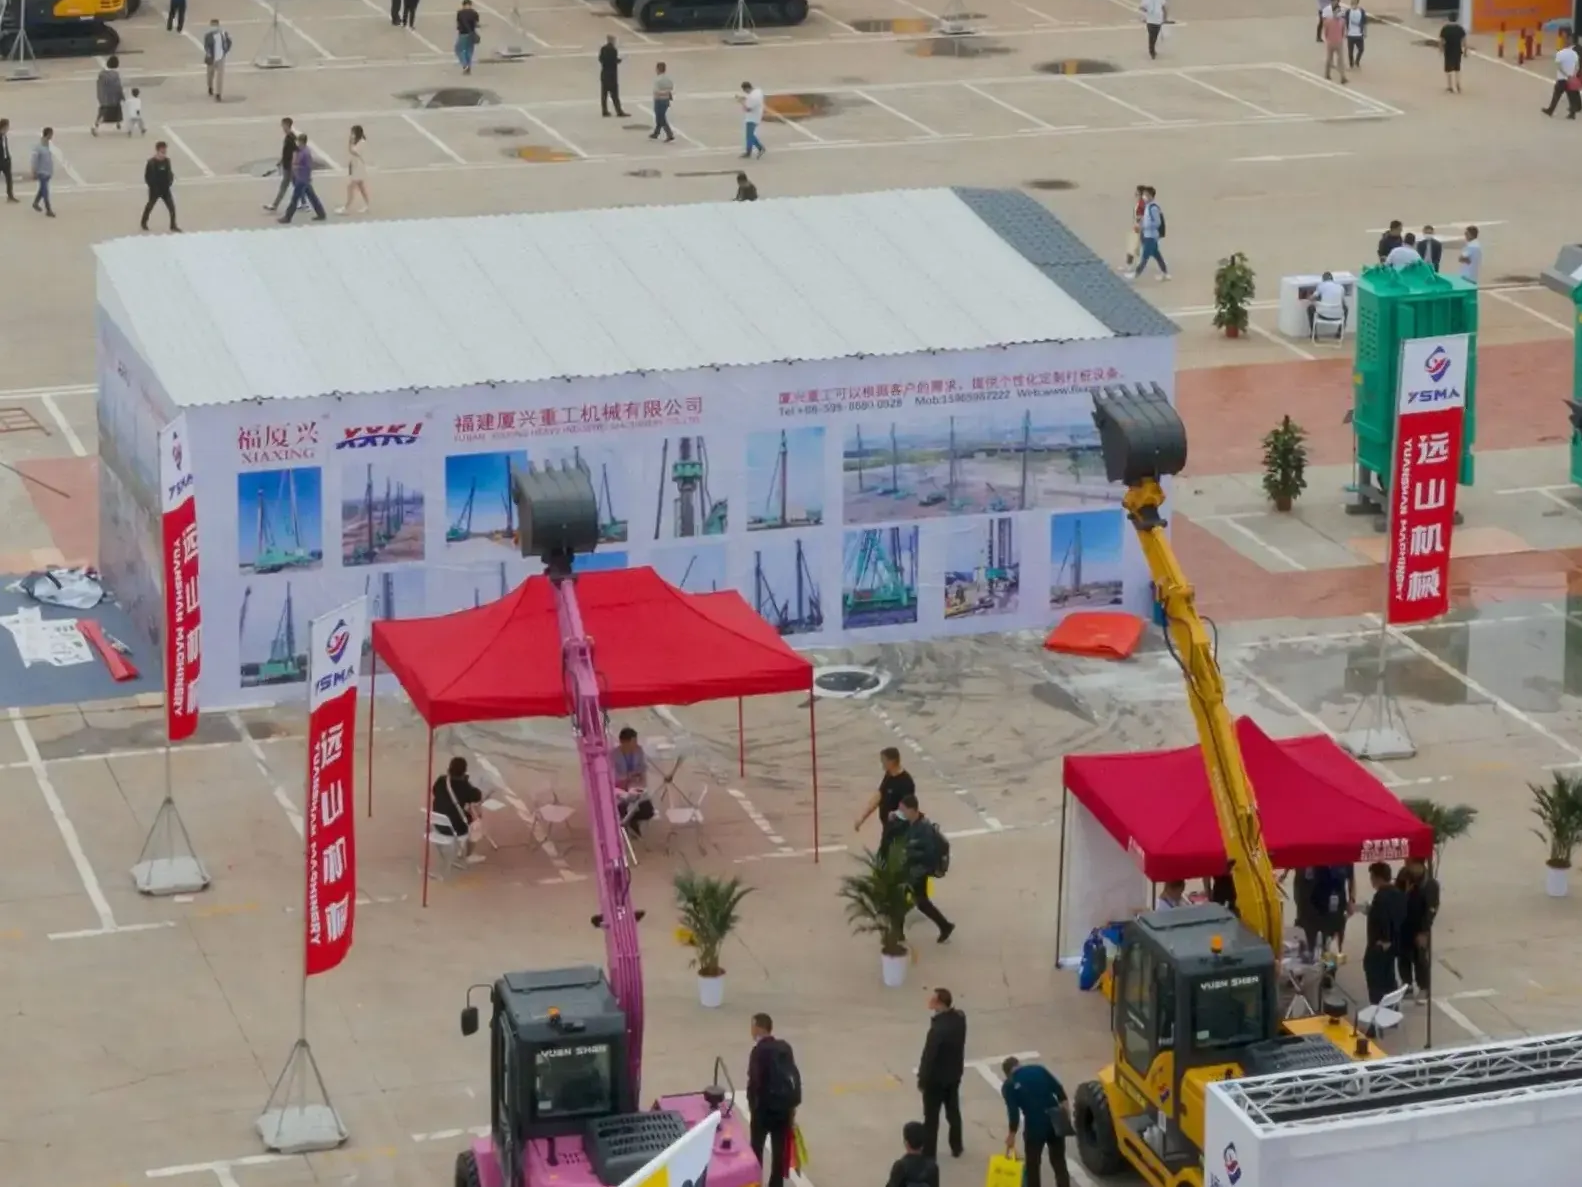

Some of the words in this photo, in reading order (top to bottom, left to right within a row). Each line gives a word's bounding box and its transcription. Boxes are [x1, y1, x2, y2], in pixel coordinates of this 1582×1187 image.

[453, 397, 703, 433] 福建厦兴重工机械有限公司
[1408, 390, 1461, 404] YSMA
[237, 421, 319, 451] 福厦兴
[242, 448, 315, 464] XIAXING
[1407, 432, 1449, 602] 远山机械
[174, 626, 186, 716] MACHINERY
[319, 722, 351, 944] 远山机械
[309, 842, 321, 946] MACHINERY
